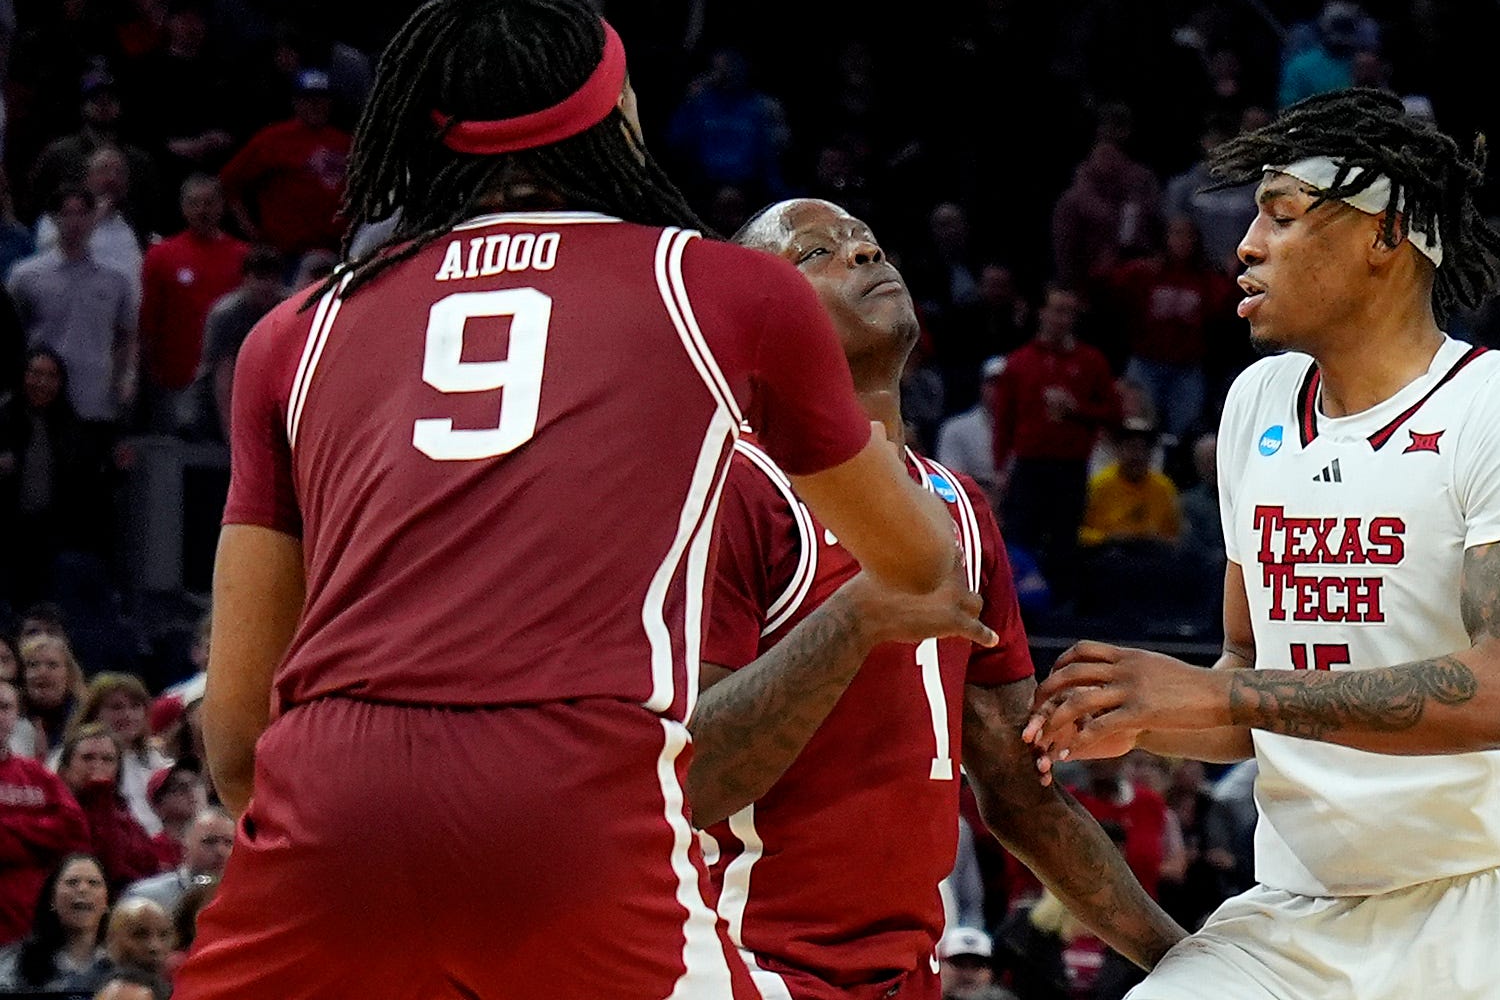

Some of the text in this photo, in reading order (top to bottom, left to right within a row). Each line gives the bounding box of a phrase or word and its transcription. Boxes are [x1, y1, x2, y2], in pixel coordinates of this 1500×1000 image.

[435, 232, 561, 281] AIDOO
[412, 286, 553, 461] 9
[1253, 505, 1406, 565] TEXAS
[1262, 563, 1385, 622] TECH
[916, 637, 953, 780] 1
